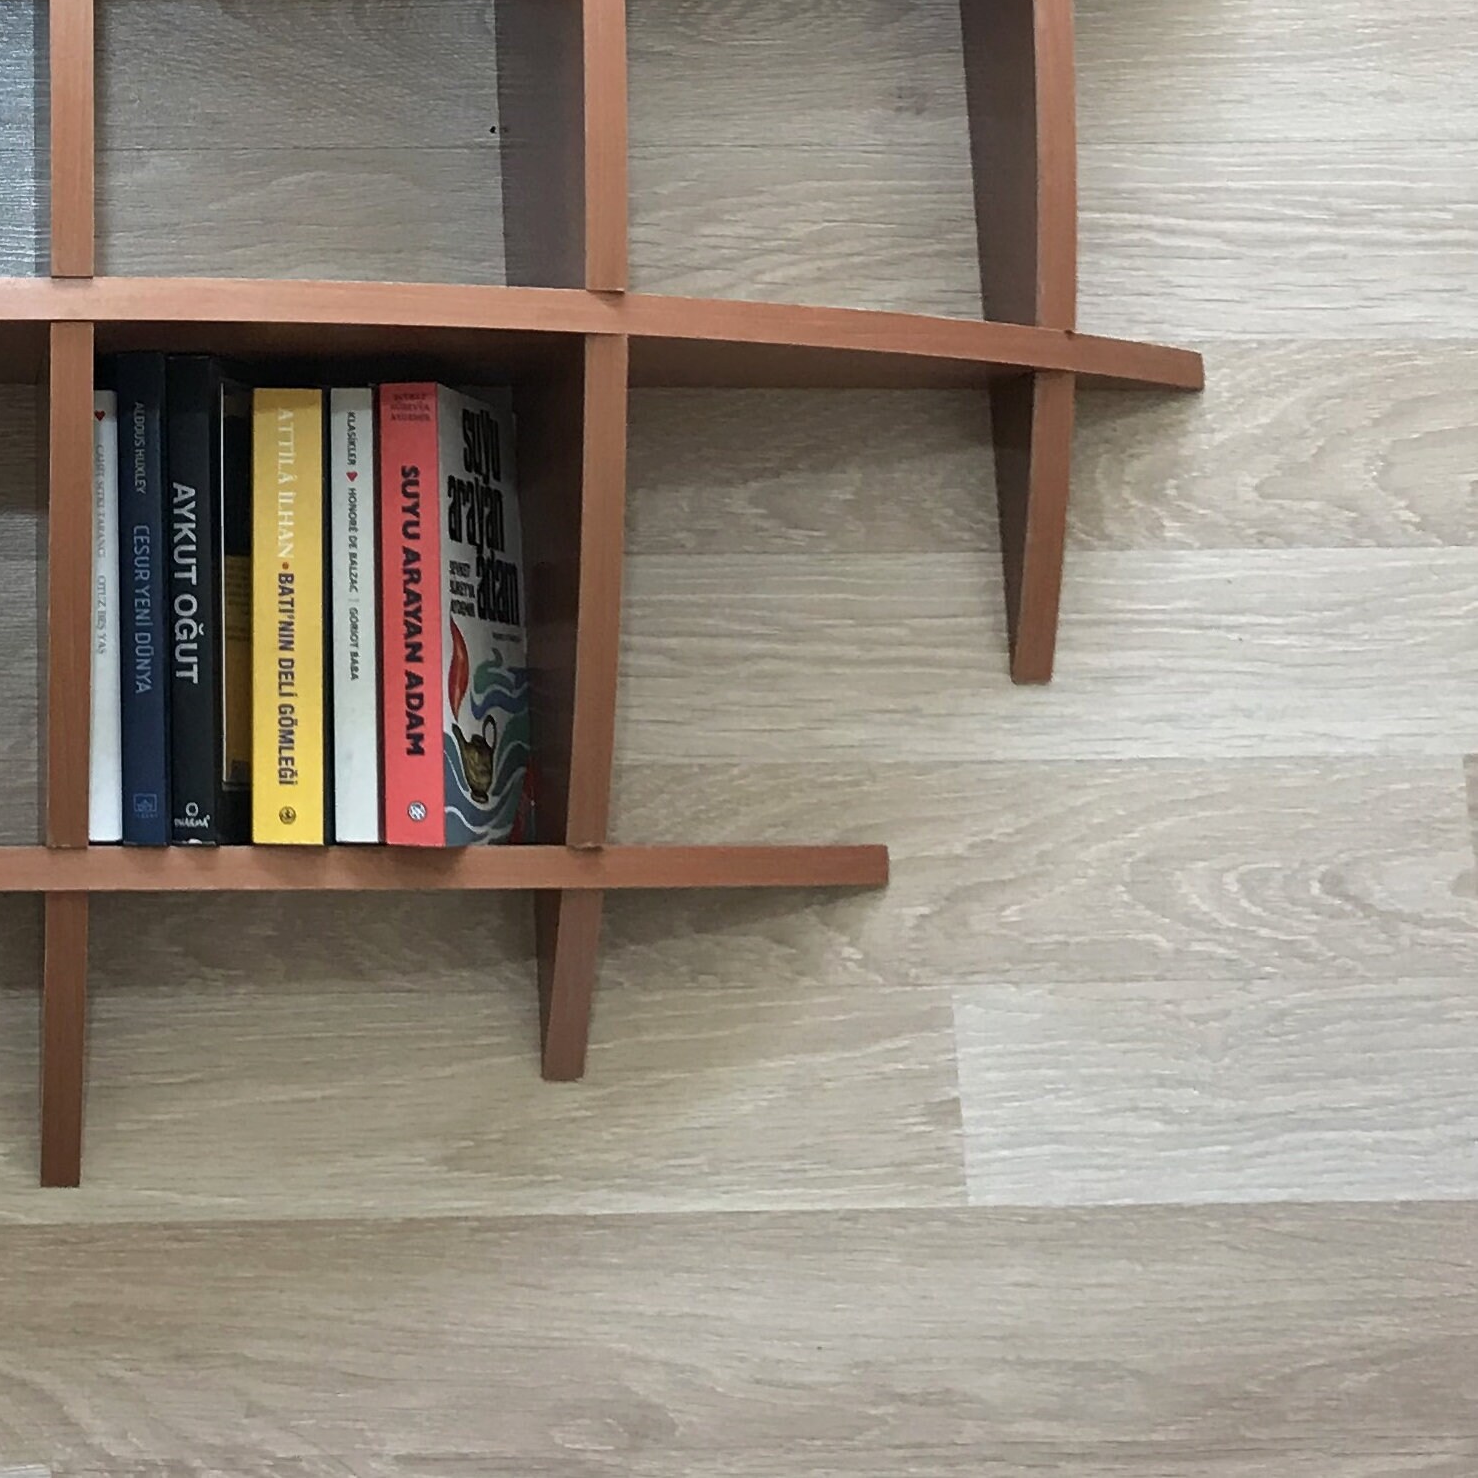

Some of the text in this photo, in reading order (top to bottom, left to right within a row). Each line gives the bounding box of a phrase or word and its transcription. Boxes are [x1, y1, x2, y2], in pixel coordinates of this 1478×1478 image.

[133, 402, 147, 495] ALDOUS HUXLEY
[277, 491, 297, 559] İLHAN
[133, 524, 155, 694] CESUR YENİ DÜNYA
[172, 482, 205, 684] AYKUT OĞUT
[348, 551, 359, 593] BALZAC
[401, 465, 425, 756] SUYU ARAYAN ADAM
[278, 657, 298, 698] DELİ
[349, 650, 360, 681] BABA
[278, 703, 298, 786] GÖMLEĞİ
